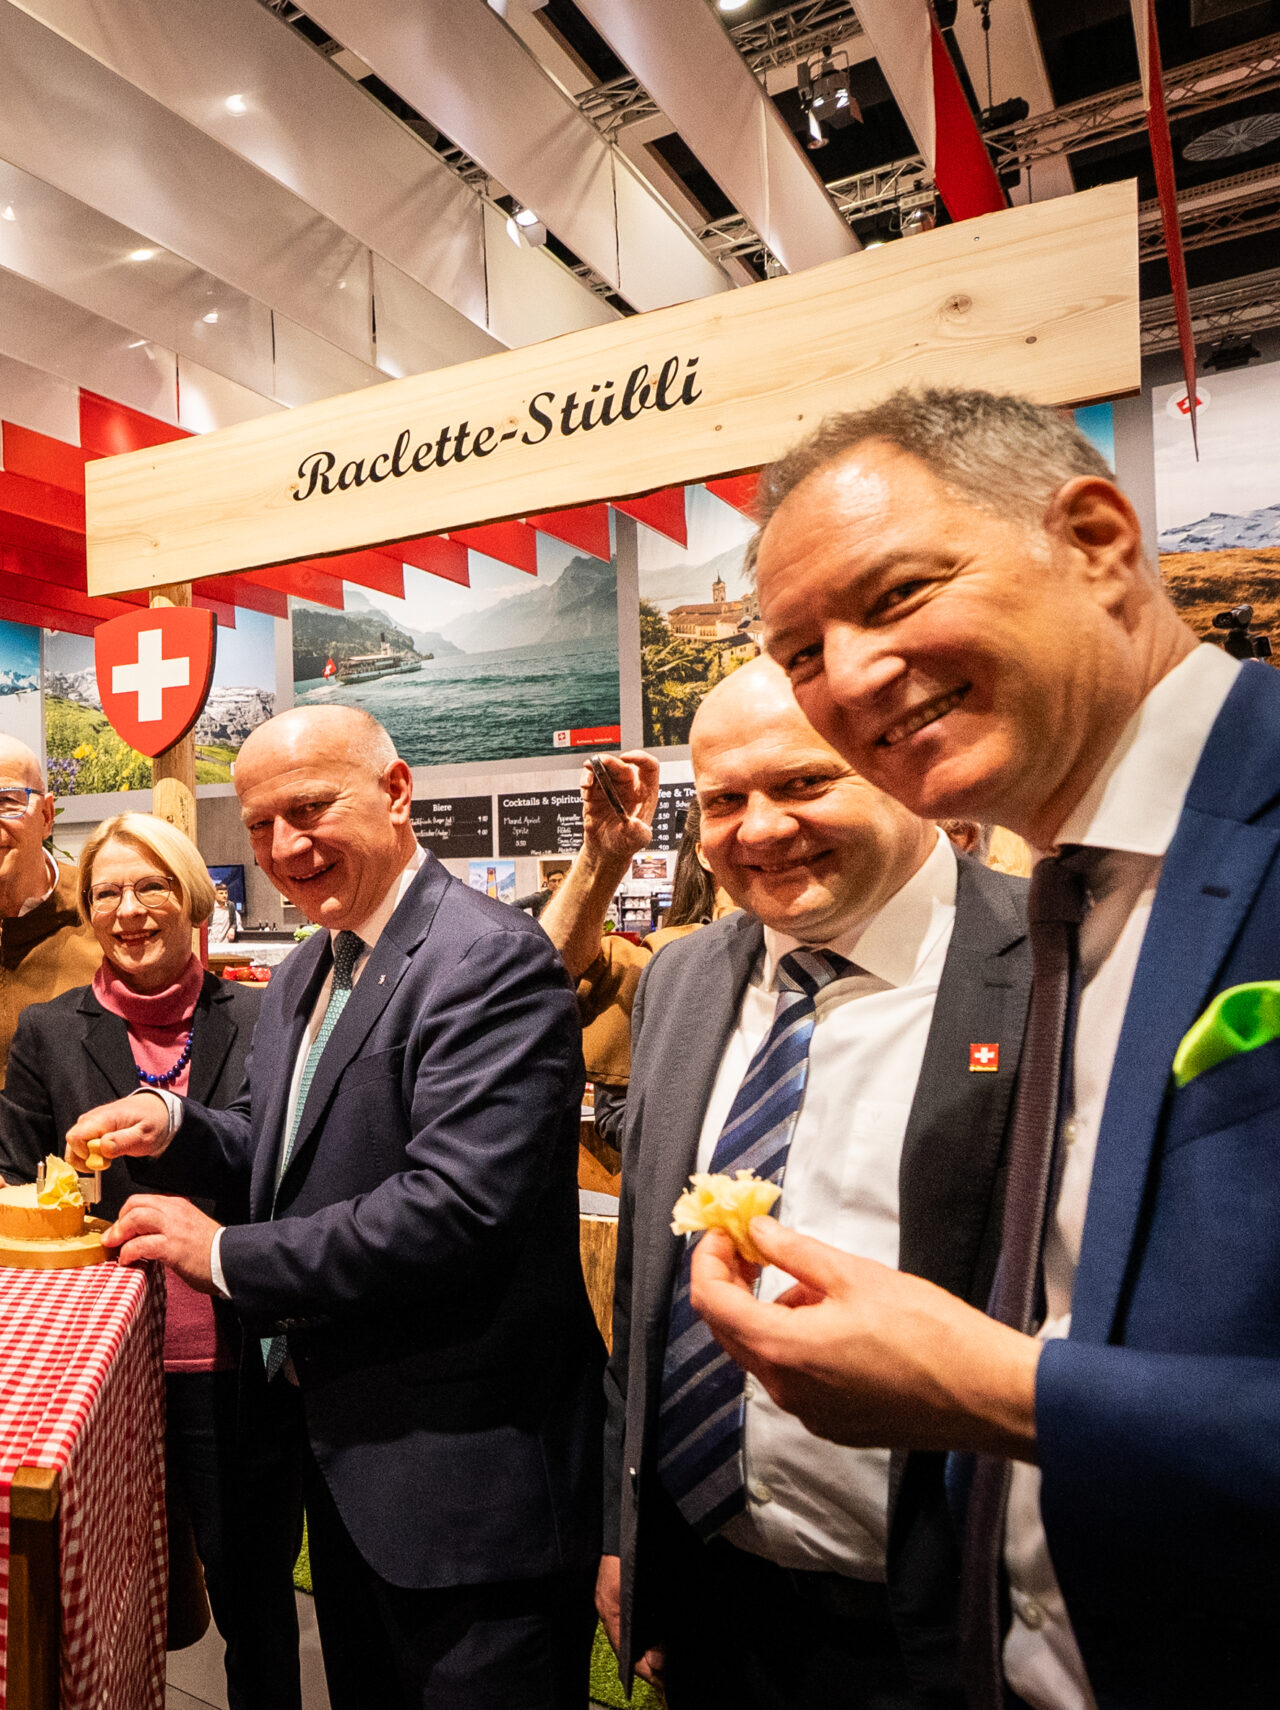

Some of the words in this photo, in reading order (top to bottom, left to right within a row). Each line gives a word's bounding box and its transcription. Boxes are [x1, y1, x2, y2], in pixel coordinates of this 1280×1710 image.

[292, 356, 702, 501] Raclette-Stübli
[503, 797, 540, 807] Cocktails
[542, 797, 549, 805] &
[432, 803, 453, 812] Biere
